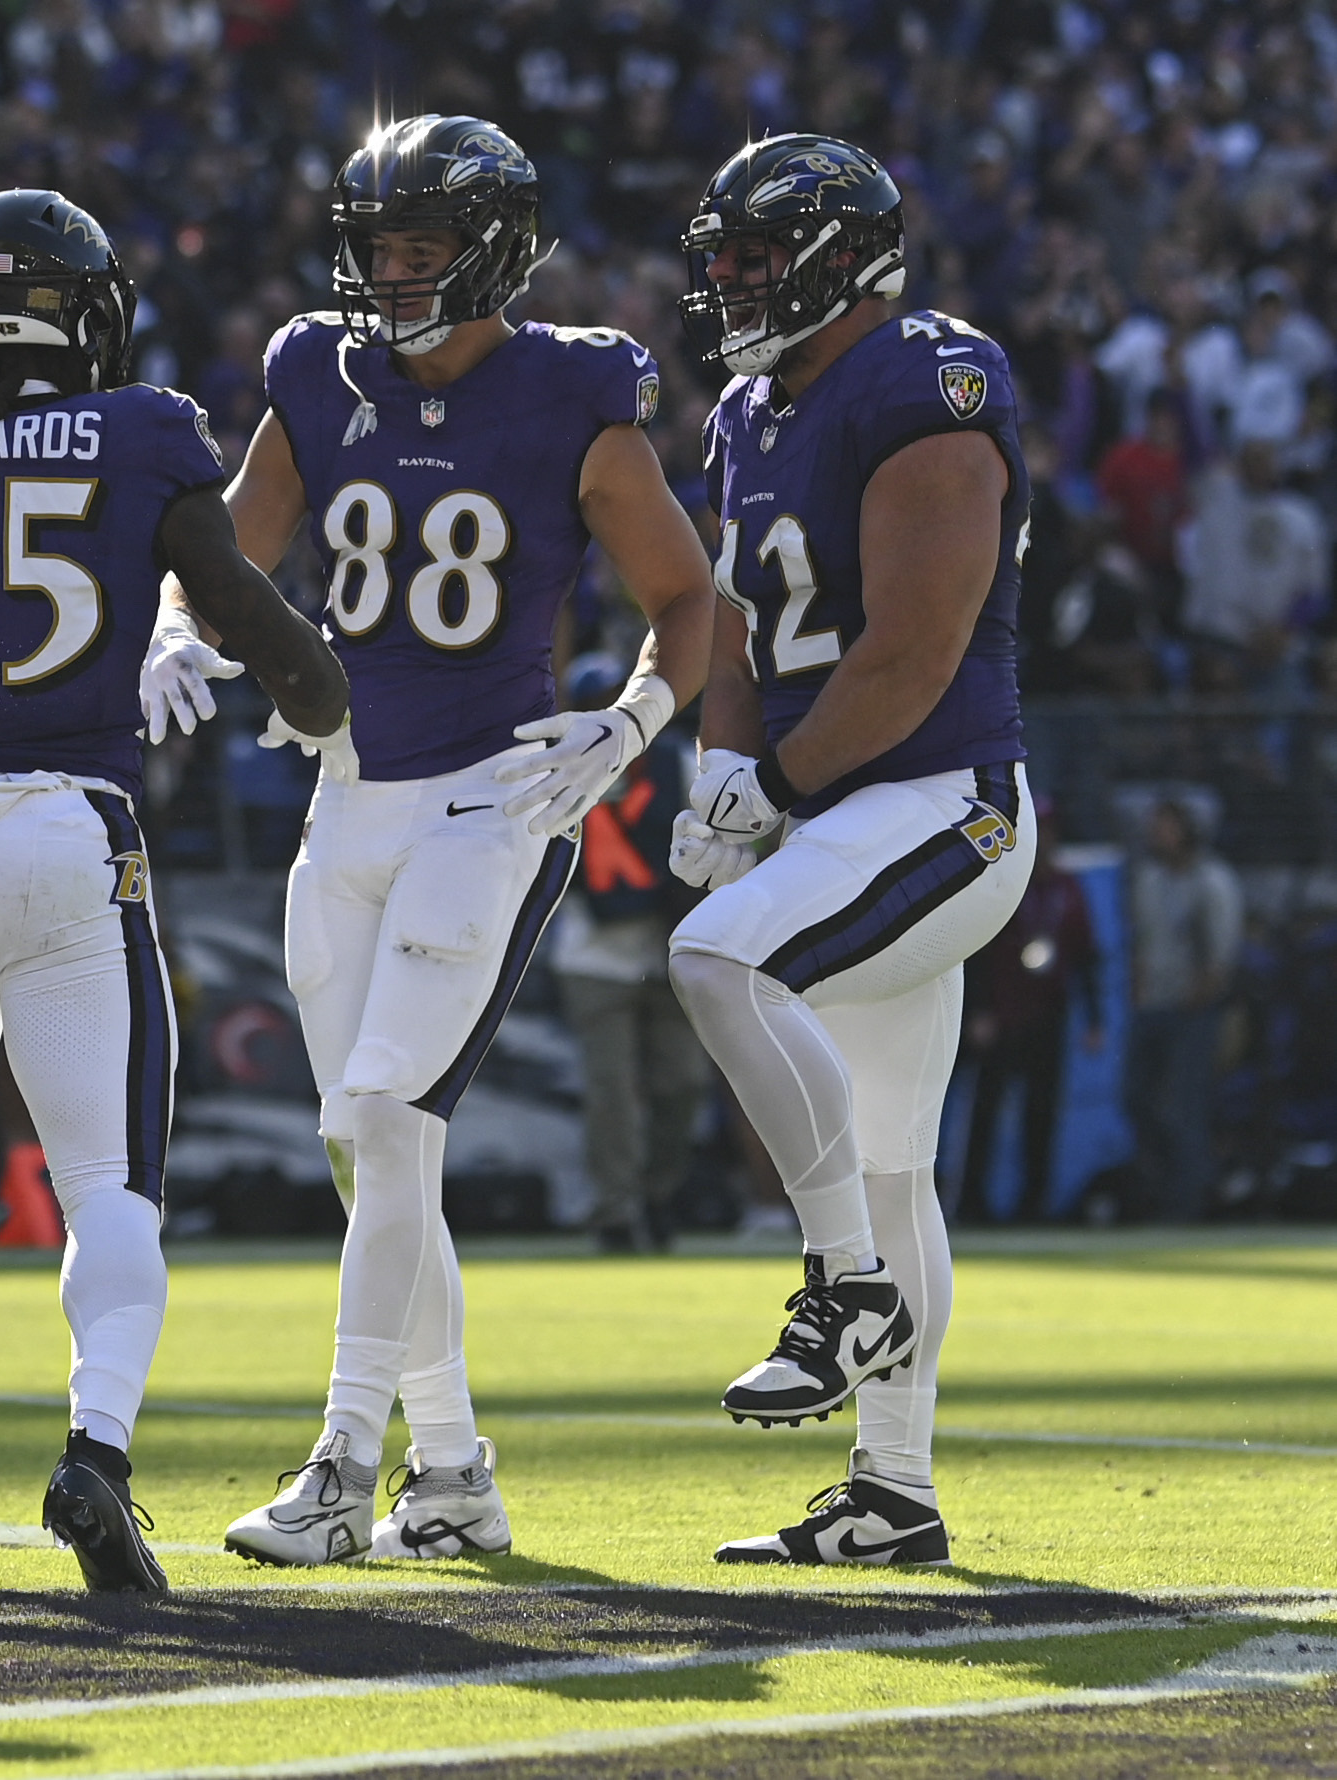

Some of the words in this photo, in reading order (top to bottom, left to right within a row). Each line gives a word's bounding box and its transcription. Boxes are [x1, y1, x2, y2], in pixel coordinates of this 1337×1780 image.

[945, 367, 981, 378] RAVENS
[397, 457, 455, 471] RAVENS
[741, 492, 775, 506] RAVENS
[323, 478, 511, 650] 88
[951, 796, 1017, 864] B
[103, 849, 149, 905] B
